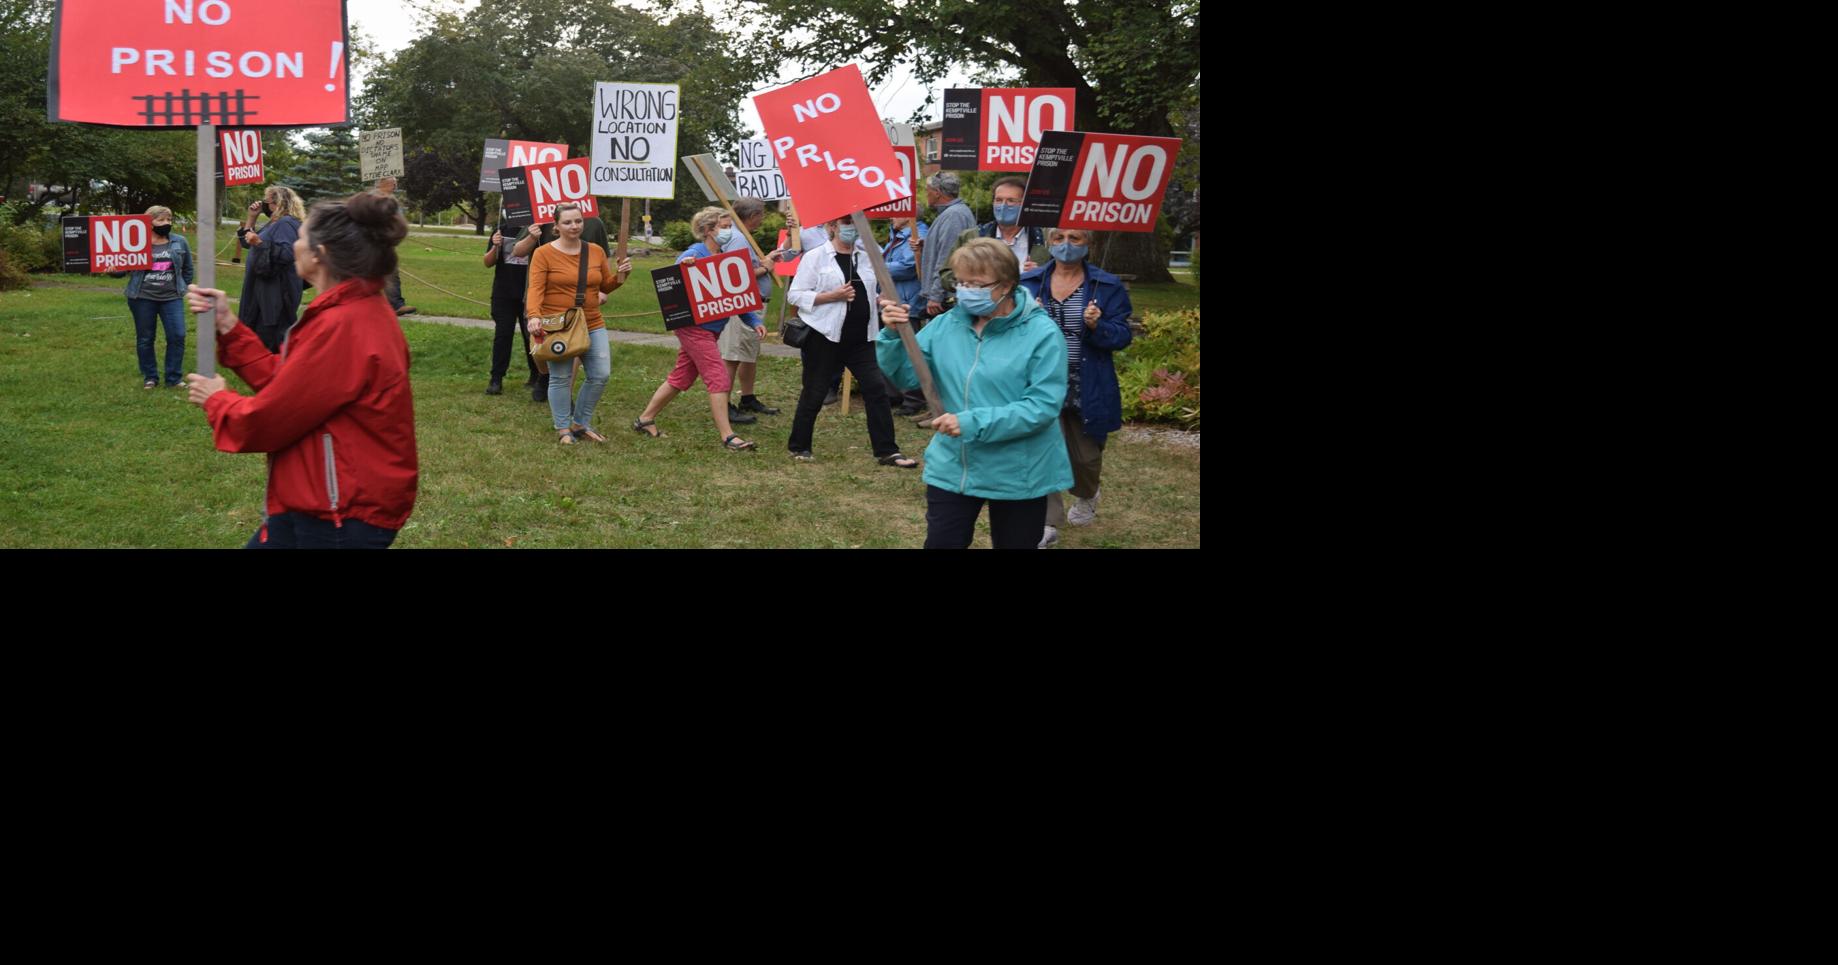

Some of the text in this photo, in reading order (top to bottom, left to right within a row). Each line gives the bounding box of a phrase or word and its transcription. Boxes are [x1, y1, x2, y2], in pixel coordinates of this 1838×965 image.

[164, 0, 231, 26] NO
[600, 88, 676, 120] WRONG
[792, 92, 841, 123] NO
[598, 121, 666, 134] LOCATION
[987, 94, 1066, 144] NO
[224, 130, 259, 166] NO
[611, 136, 650, 161] NO
[740, 142, 768, 168] NG
[987, 145, 1040, 165] PRIS
[1039, 154, 1074, 162] KEMPTVILLE
[228, 164, 260, 180] PRISON
[595, 166, 673, 181] CONSULTATION
[773, 136, 912, 201] PRISON
[1076, 142, 1167, 201] NO
[531, 163, 588, 203] NO
[738, 173, 792, 199] BAD D
[1069, 200, 1152, 224] PRISON
[95, 219, 147, 253] NO
[96, 252, 148, 268] PRISON
[688, 257, 750, 302] NO
[698, 292, 756, 318] PRISON
